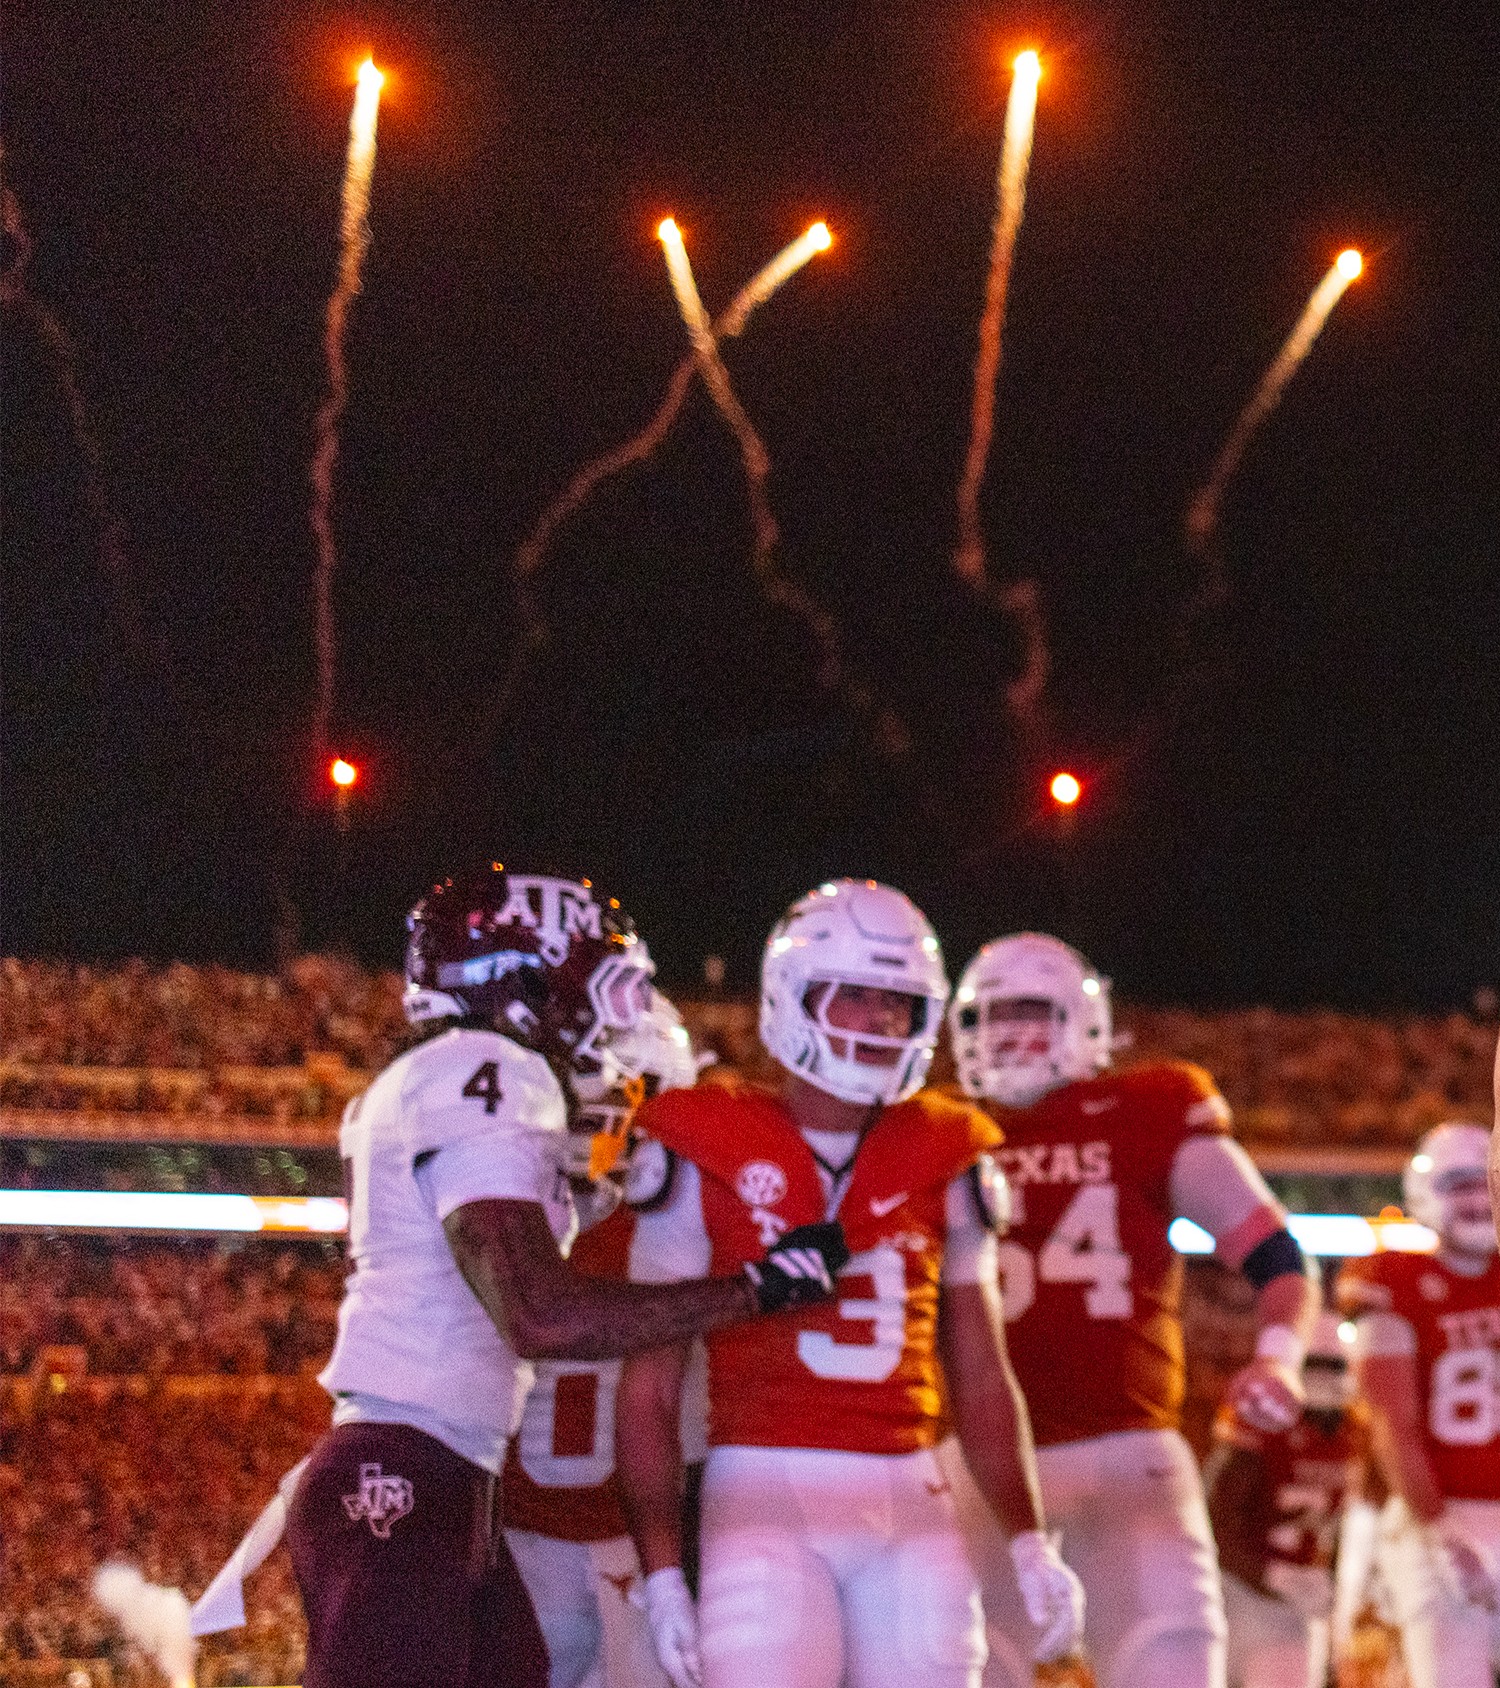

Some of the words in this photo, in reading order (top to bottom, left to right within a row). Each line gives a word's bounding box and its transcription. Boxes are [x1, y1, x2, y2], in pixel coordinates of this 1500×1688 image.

[462, 1060, 503, 1116] 4
[990, 1141, 1112, 1184] EXAS
[797, 1246, 906, 1382] 3
